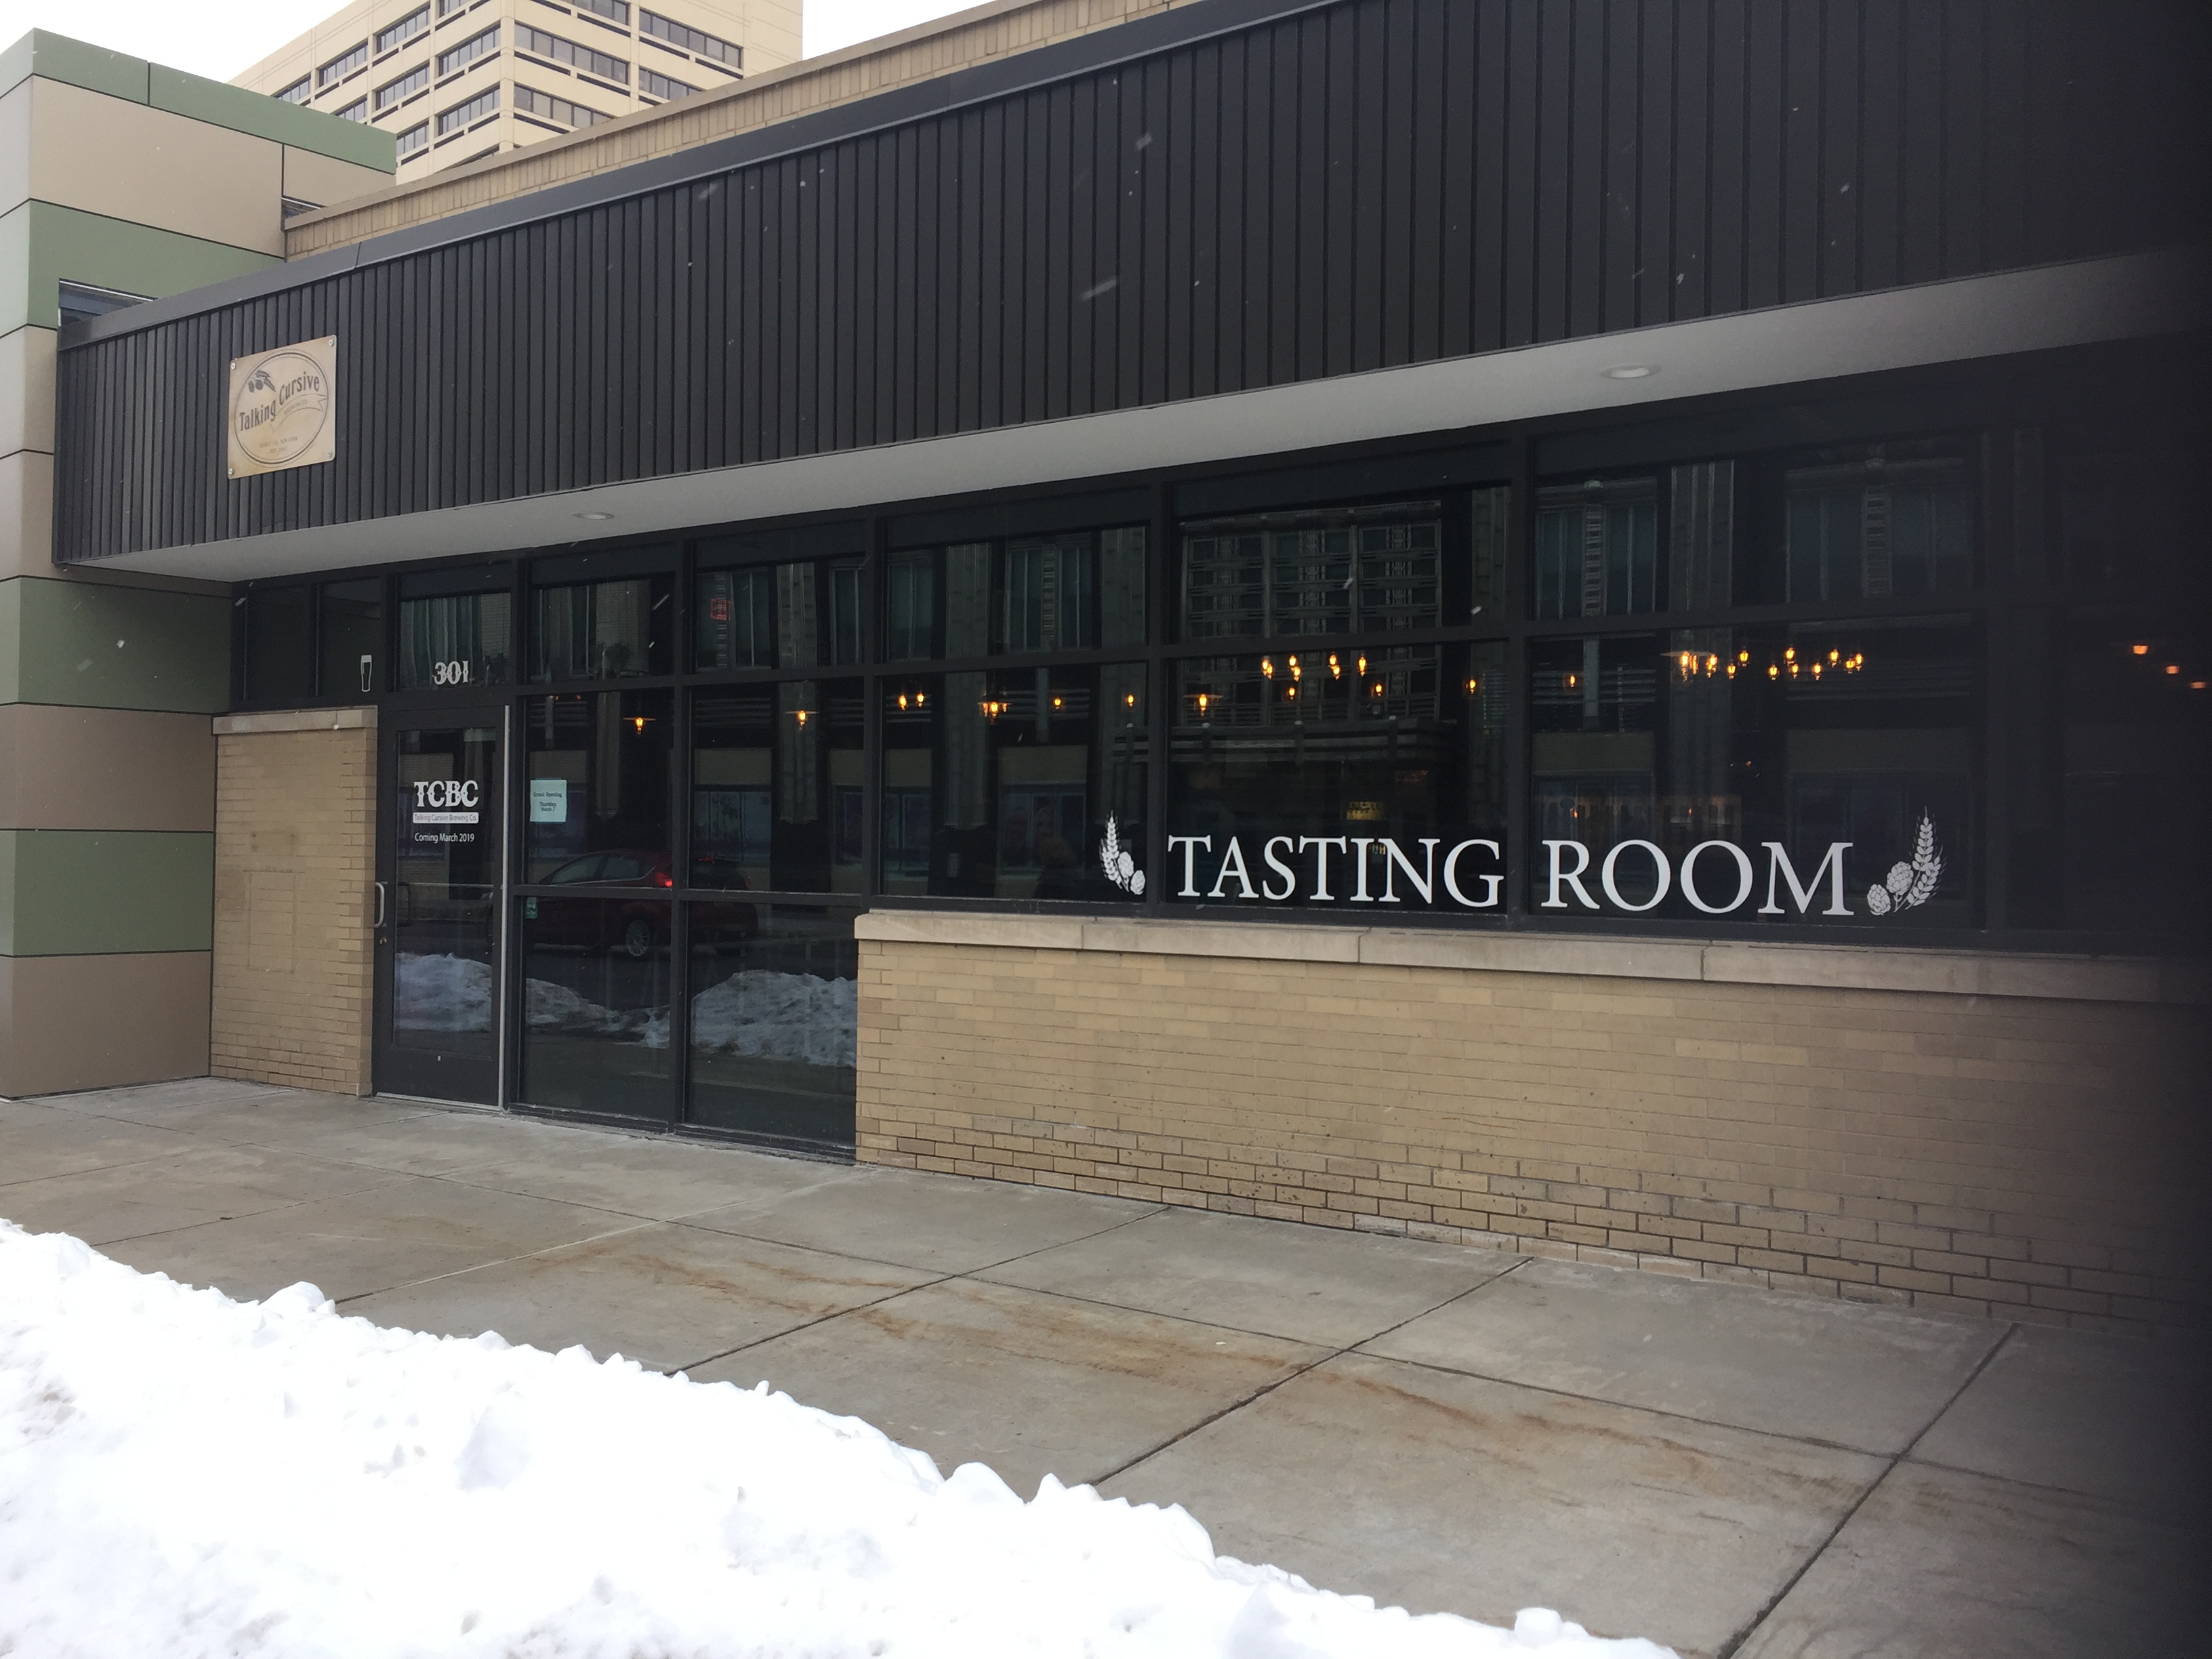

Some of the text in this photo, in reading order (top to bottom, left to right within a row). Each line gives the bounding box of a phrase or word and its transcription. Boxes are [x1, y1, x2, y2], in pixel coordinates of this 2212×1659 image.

[239, 399, 276, 431] Talking
[279, 371, 320, 405] Cursive
[434, 660, 470, 685] 301
[413, 780, 479, 808] TCBC
[414, 814, 431, 822] Talking
[449, 814, 468, 822] Brewing
[415, 832, 474, 844] Coming March 2019
[1168, 834, 1854, 916] TASTING ROOM
